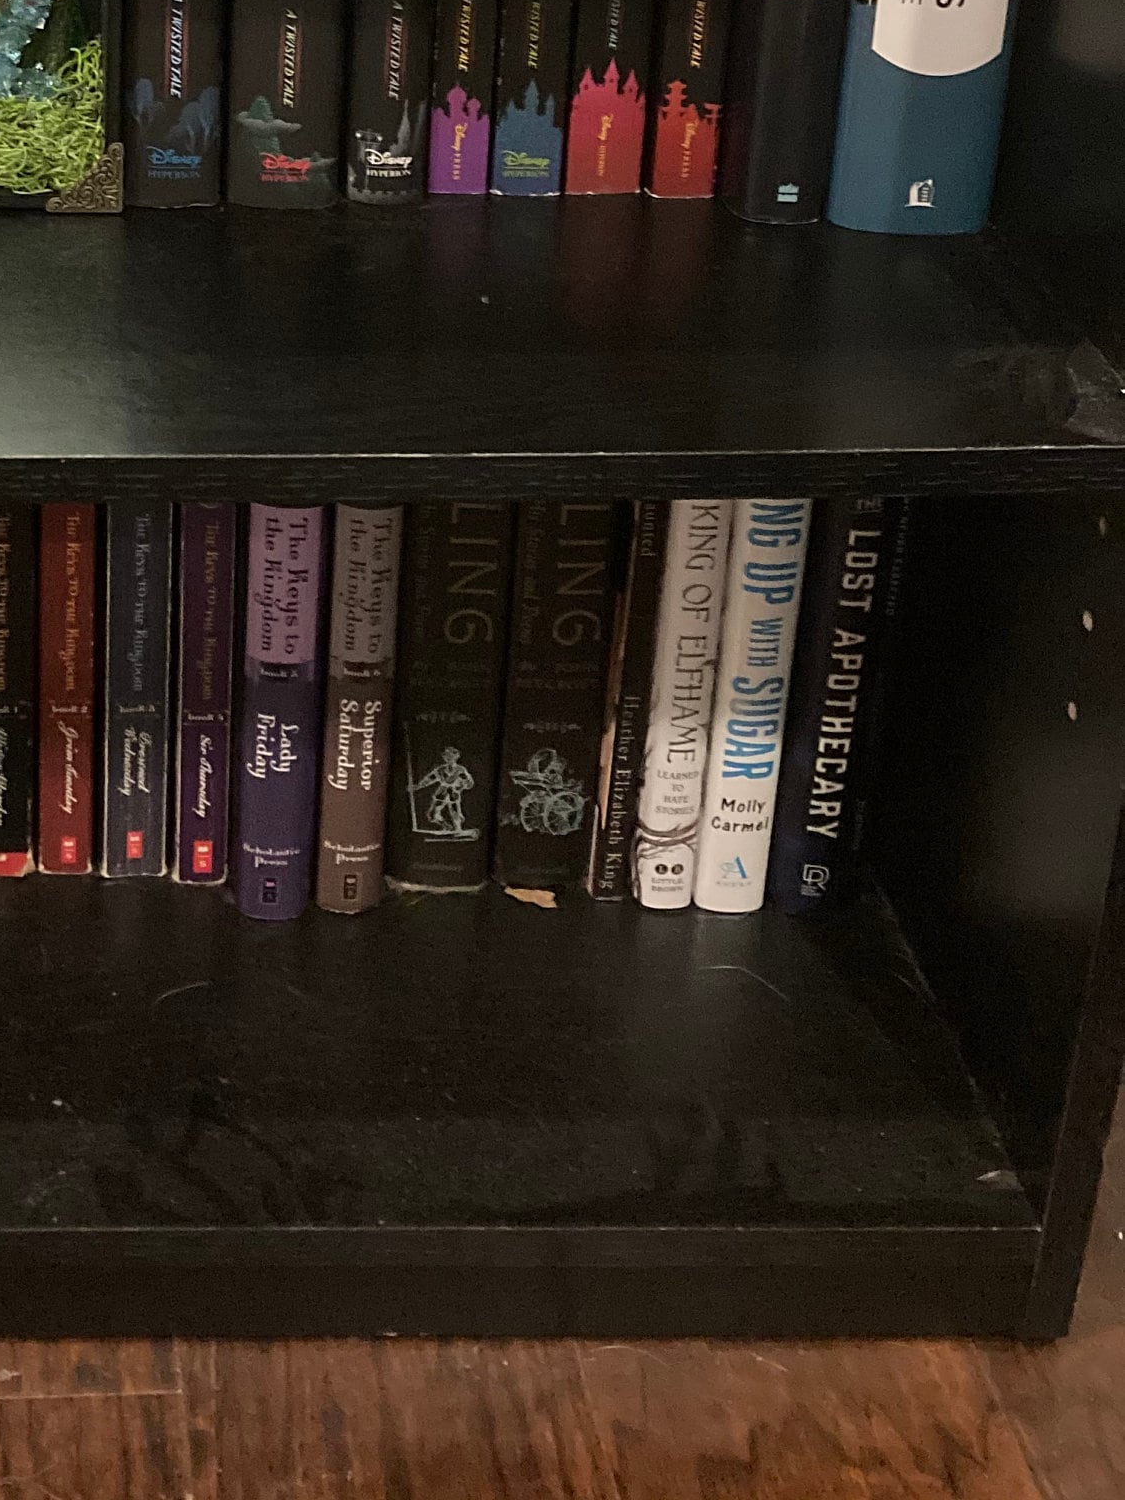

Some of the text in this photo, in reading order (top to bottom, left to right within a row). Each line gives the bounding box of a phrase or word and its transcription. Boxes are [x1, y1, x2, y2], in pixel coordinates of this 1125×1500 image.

[170, 7, 184, 99] TWISTED TALE
[362, 148, 412, 169] Disney
[254, 517, 283, 652] the Kingdom
[284, 517, 310, 655] The Keys to
[666, 503, 721, 764] KING OF ELFHAME
[722, 562, 799, 781] UP WITH SUGAR
[807, 529, 881, 840] LOST APOTHECARY
[246, 713, 276, 779] Friday
[270, 723, 299, 773] Lady
[328, 699, 359, 791] Saturday
[362, 700, 382, 791] Superior
[598, 696, 640, 890] Heather Elizabeth King
[711, 816, 769, 833] Carmel
[721, 798, 766, 814] Molly
